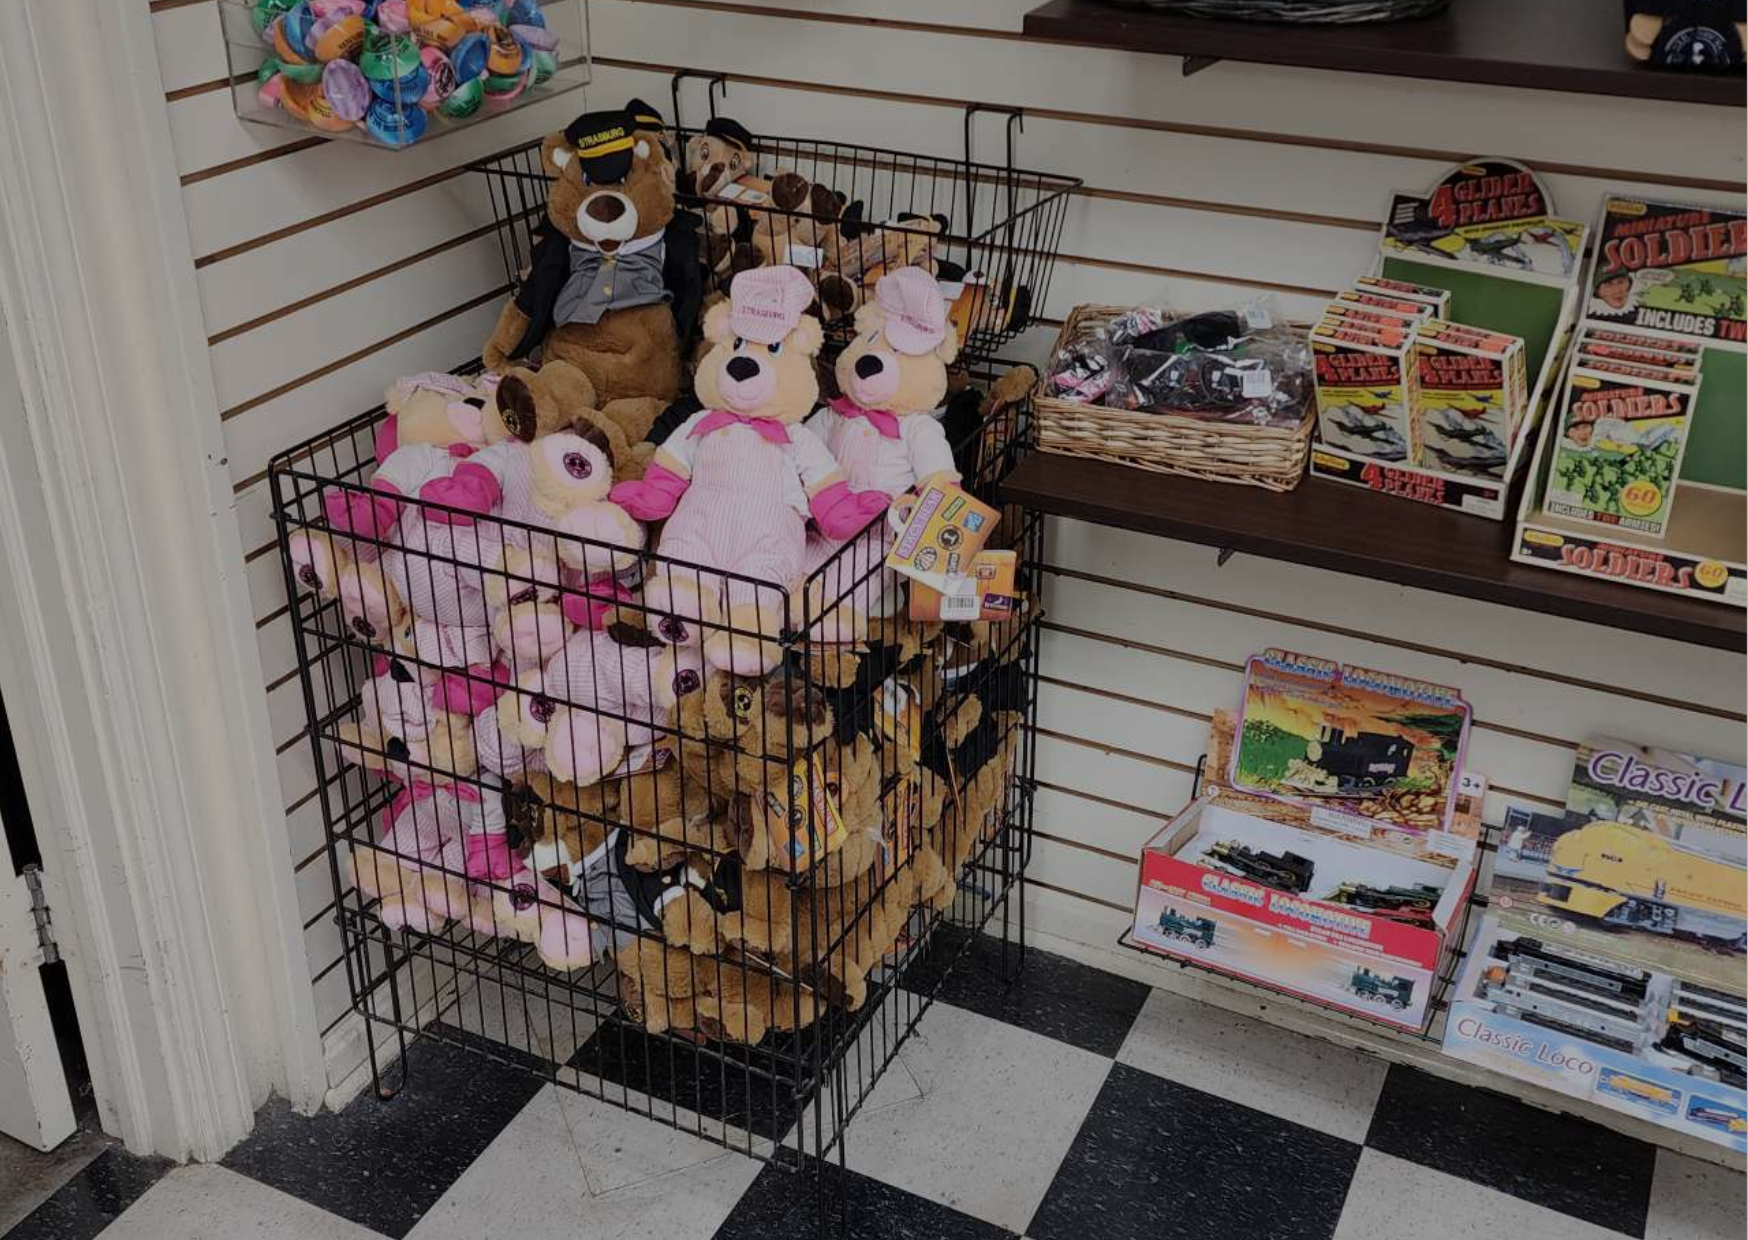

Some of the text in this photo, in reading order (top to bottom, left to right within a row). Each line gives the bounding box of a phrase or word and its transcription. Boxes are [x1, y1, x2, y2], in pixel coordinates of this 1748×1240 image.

[577, 126, 625, 148] STRASBURG
[1429, 185, 1455, 228] 4
[1454, 171, 1534, 200] GLIDER
[1458, 194, 1541, 223] PLANES
[1611, 210, 1711, 237] MINIATURE
[1634, 306, 1716, 336] INCLUDES
[1329, 353, 1391, 369] GLIDER
[1336, 365, 1400, 382] PLANES
[1430, 355, 1494, 371] GLIDER
[1438, 370, 1502, 384] PLANES
[1569, 393, 1682, 423] SOLDIERS
[1360, 462, 1445, 491] 4 GLIDER
[1384, 478, 1446, 504] PLANES
[1626, 487, 1656, 504] 60
[1549, 501, 1595, 520] INCLUDES
[1557, 543, 1694, 589] SOLDIERS
[1699, 564, 1723, 579] 60
[1263, 648, 1338, 681] CLASSIC
[1461, 777, 1481, 791] 3+
[1590, 751, 1718, 806] Classic
[1456, 1018, 1594, 1077] Classic Loco
